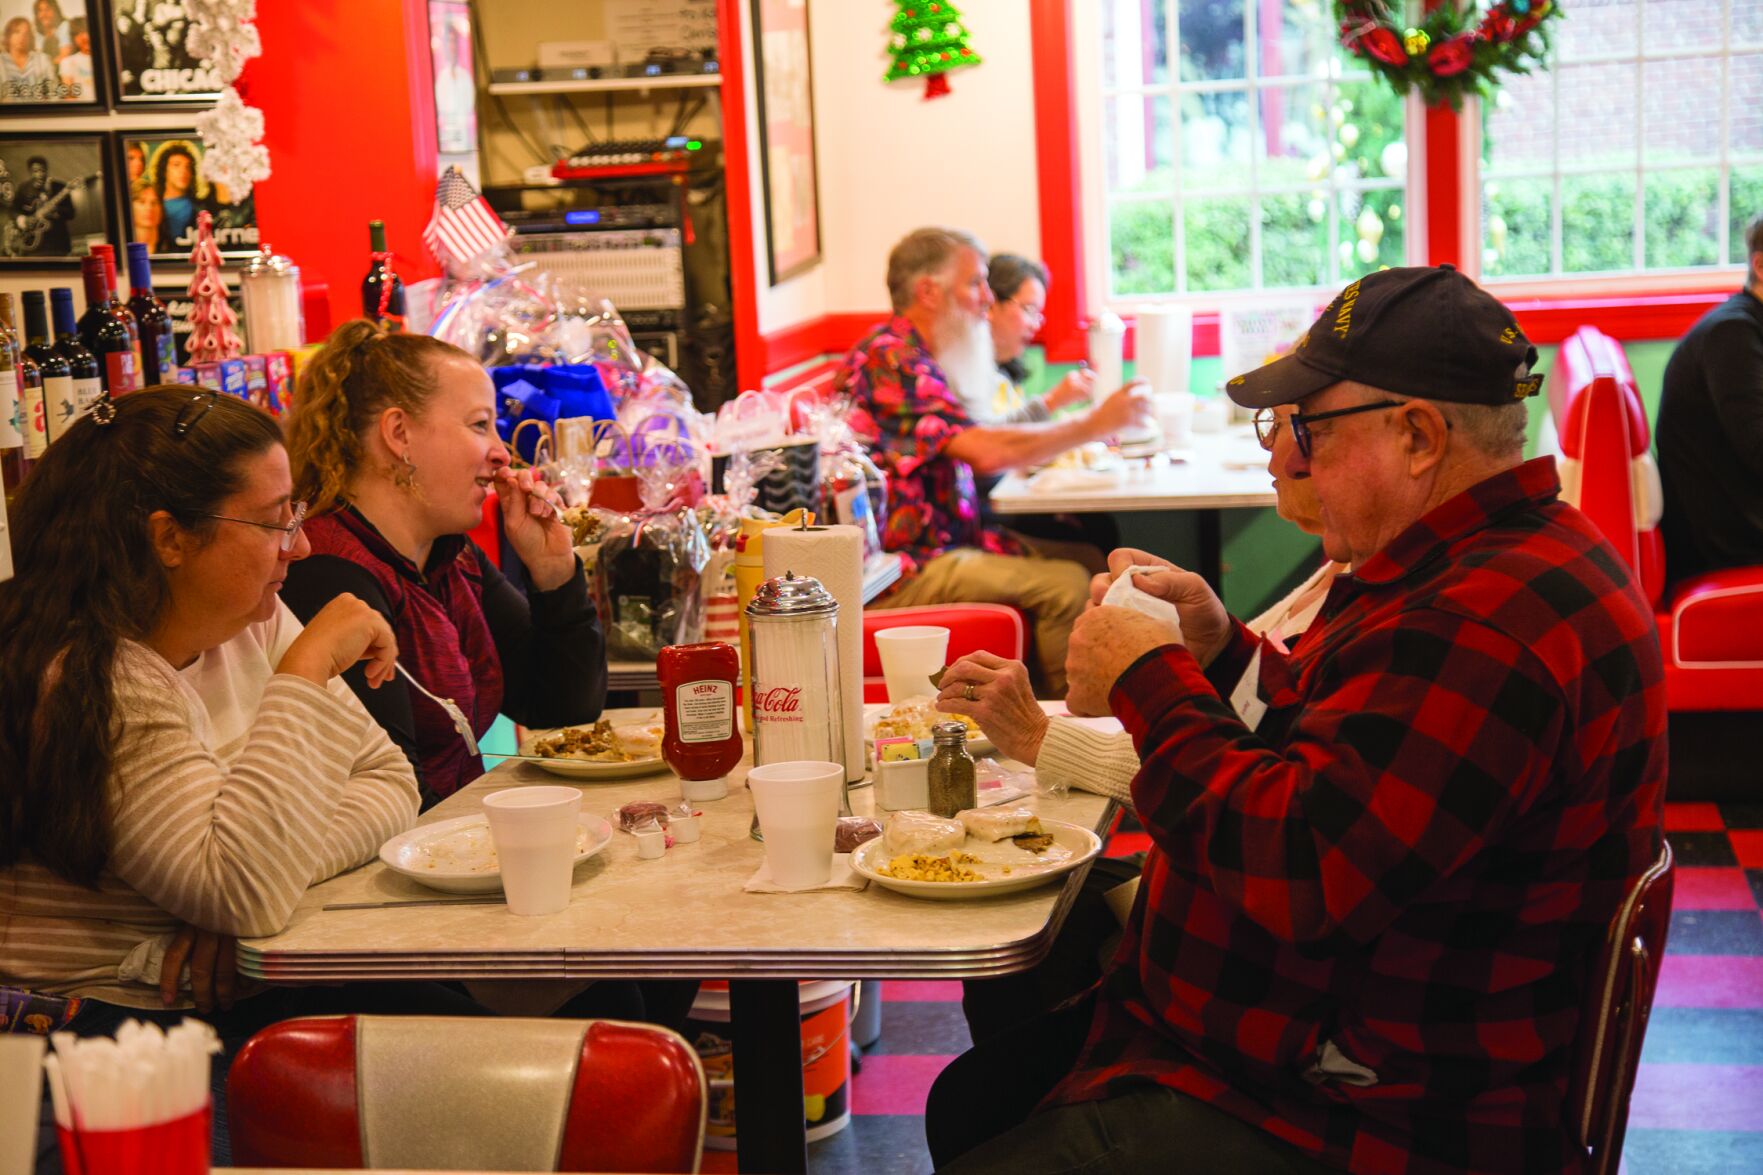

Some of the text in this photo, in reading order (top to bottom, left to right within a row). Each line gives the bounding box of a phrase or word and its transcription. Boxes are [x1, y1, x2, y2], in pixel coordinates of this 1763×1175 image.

[7, 78, 82, 99] Eagles
[140, 67, 224, 92] CHICAG
[1333, 299, 1356, 332] NAVY
[693, 684, 718, 695] HEINZ
